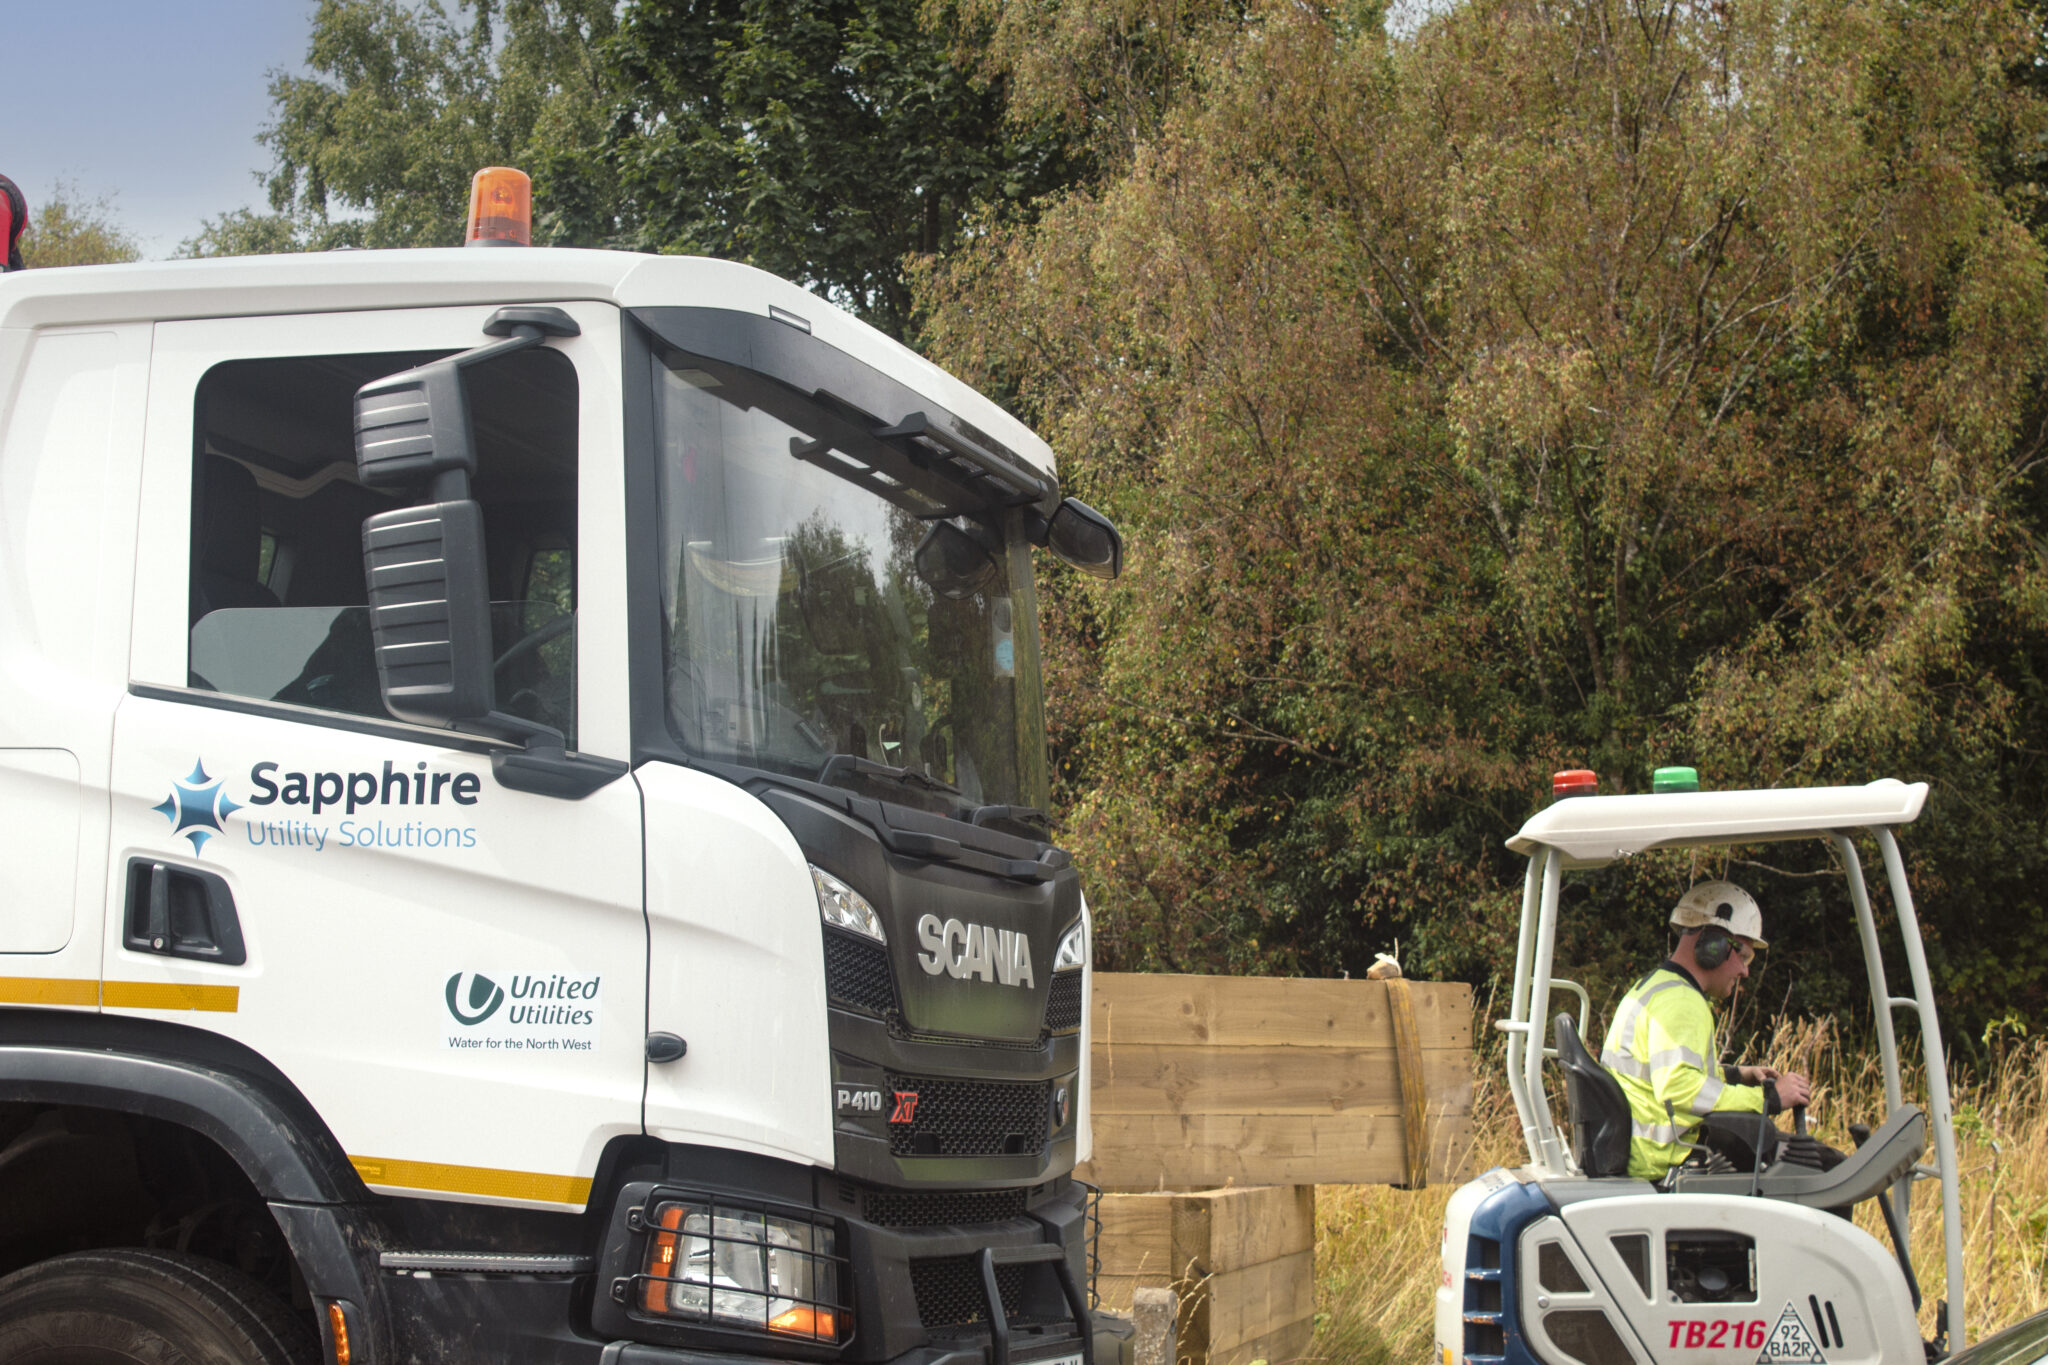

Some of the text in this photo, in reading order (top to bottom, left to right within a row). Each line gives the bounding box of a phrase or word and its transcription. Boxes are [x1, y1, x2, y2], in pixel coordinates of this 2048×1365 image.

[249, 760, 481, 815] Sapphire
[246, 820, 477, 852] Utility Solutions
[918, 913, 1035, 989] SCANIA
[510, 974, 601, 1000] United
[509, 1004, 594, 1025] Utilities
[448, 1036, 592, 1050] Water for the North West
[889, 1091, 919, 1123] XT
[1667, 1319, 1767, 1349] TB216
[1781, 1325, 1801, 1341] 92
[1770, 1341, 1812, 1358] BA2R
